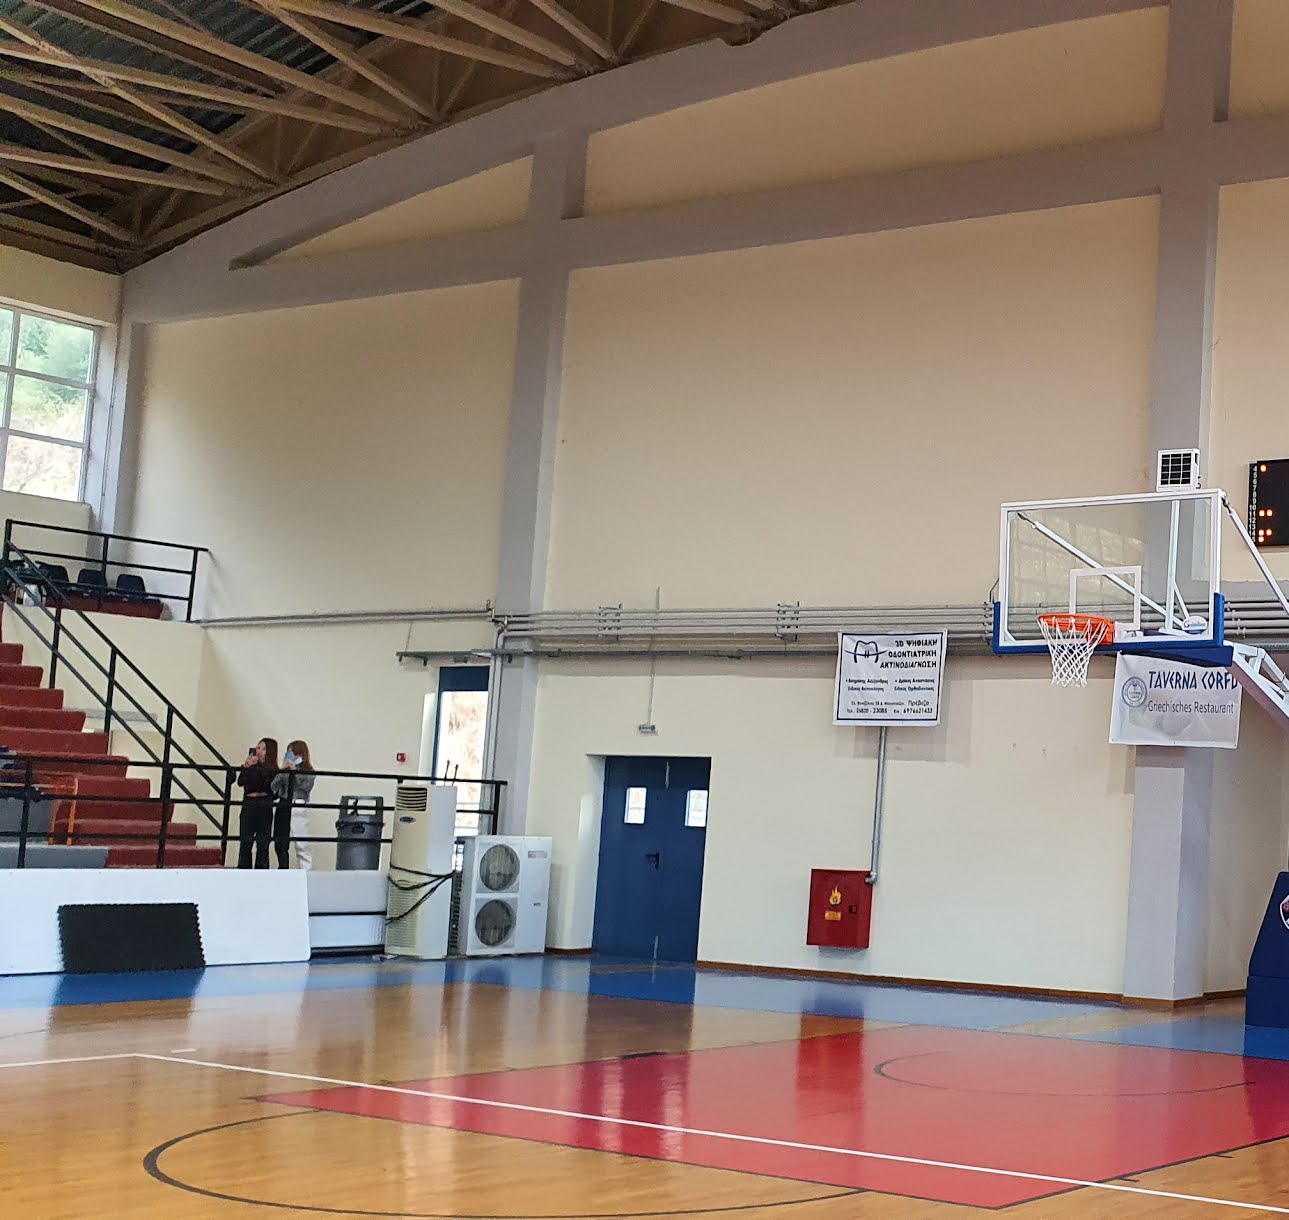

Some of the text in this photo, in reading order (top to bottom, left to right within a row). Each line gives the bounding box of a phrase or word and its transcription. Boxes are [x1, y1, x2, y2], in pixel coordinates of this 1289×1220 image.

[888, 650, 937, 658] ΟΔΟΝΤΙΑΤΡΙΚΗ
[1148, 670, 1198, 690] TAVERNA
[1147, 700, 1234, 714] Griechisches Restaurant
